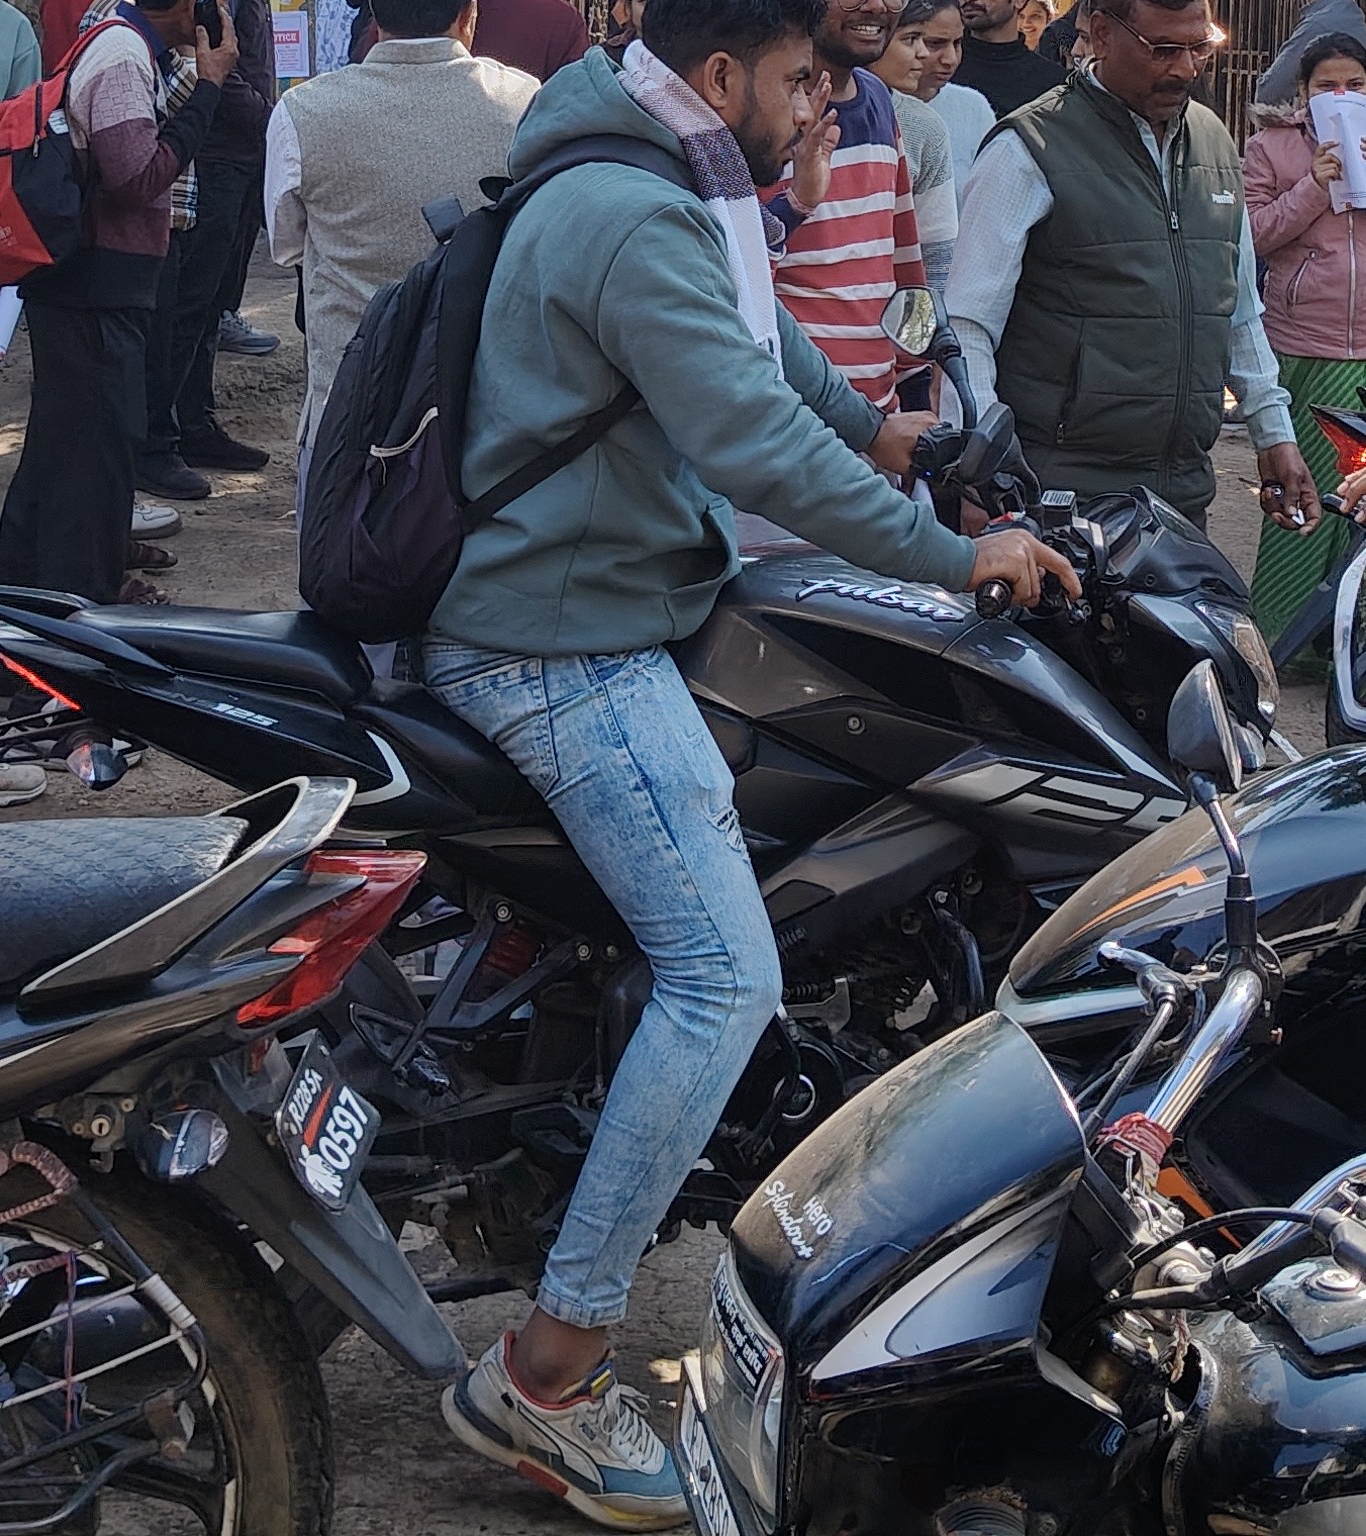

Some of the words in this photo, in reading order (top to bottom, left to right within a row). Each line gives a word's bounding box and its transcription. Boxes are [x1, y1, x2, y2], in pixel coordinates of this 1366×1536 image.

[274, 31, 297, 43] OTICE
[796, 576, 967, 622] pulsar
[319, 1085, 370, 1171] 0597
[802, 1195, 833, 1236] Hero
